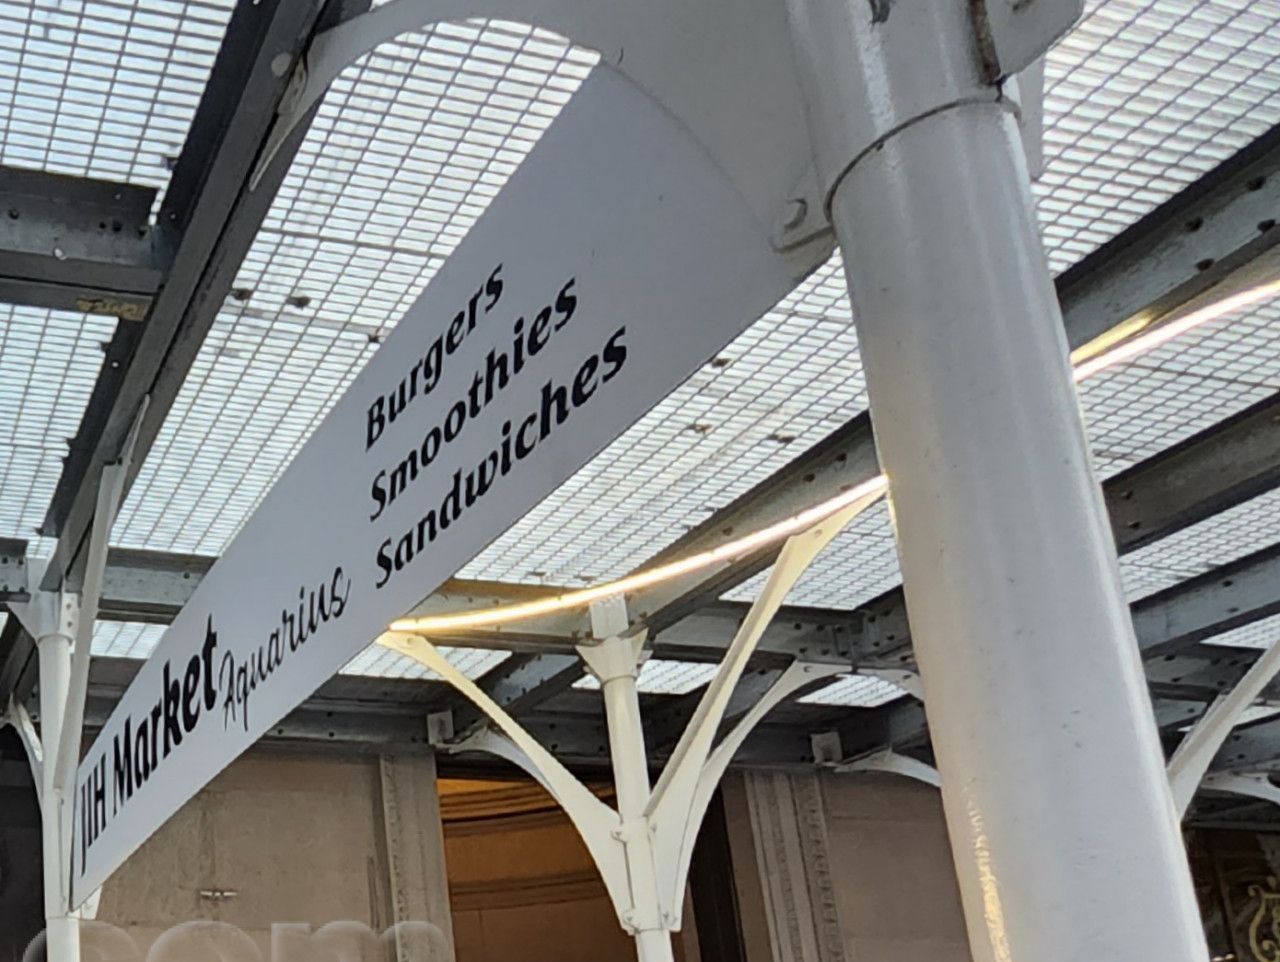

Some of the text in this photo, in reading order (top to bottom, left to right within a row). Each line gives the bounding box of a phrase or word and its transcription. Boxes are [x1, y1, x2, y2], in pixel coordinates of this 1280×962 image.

[366, 263, 504, 452] Burgers
[370, 278, 578, 521] Smoothies
[375, 327, 628, 589] Sandwiches
[113, 615, 217, 818] Market
[220, 566, 351, 733] Aquarius
